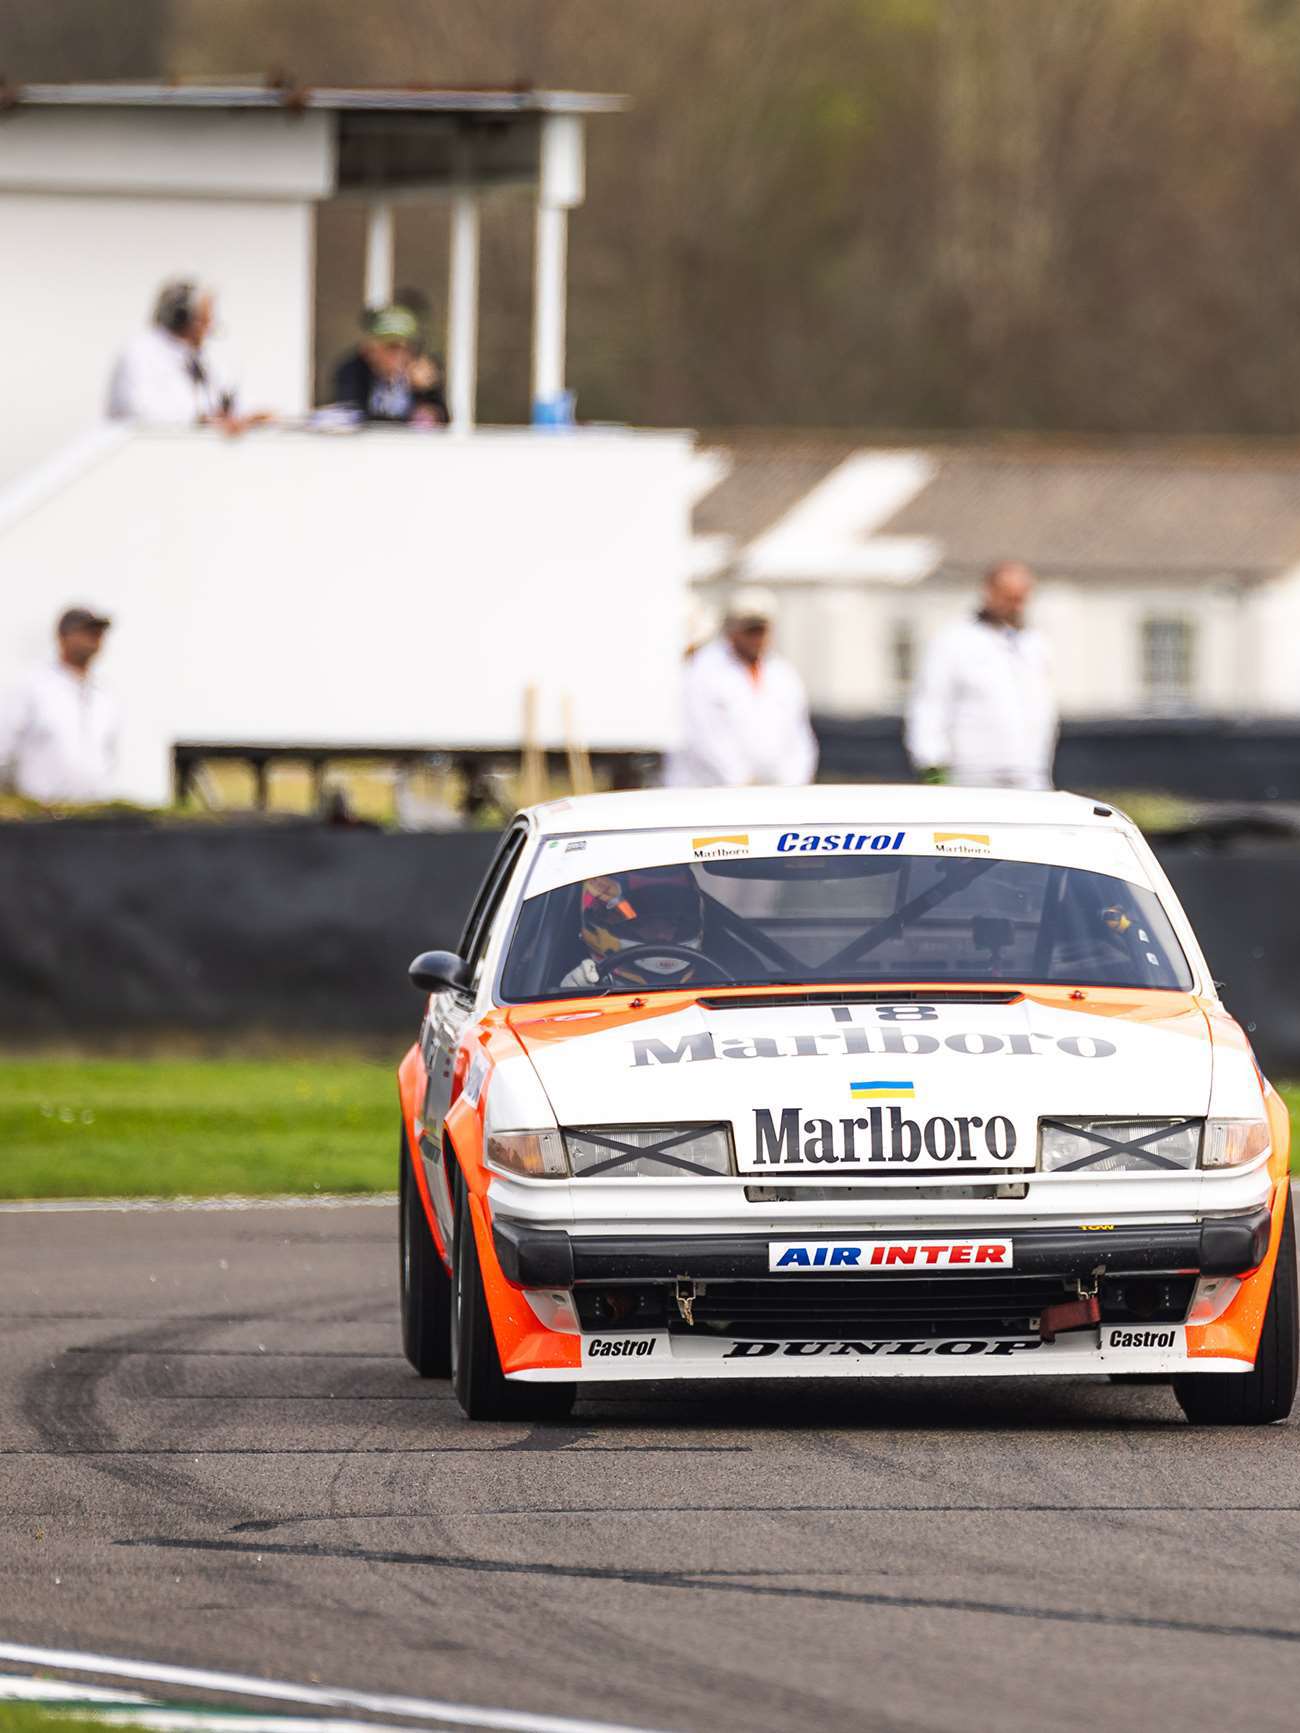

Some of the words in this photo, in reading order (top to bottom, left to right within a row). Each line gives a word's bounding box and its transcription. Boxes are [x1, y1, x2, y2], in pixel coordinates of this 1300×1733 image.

[776, 832, 906, 852] Castrol
[831, 1006, 939, 1022] 18
[629, 1027, 1117, 1068] Marlboro
[751, 1106, 1018, 1165] Marlboro
[776, 1247, 862, 1267] AIR
[870, 1245, 1007, 1265] INTER
[588, 1338, 657, 1357] Castrol
[1109, 1330, 1176, 1348] Castrol
[722, 1340, 1043, 1358] DUNLOP
